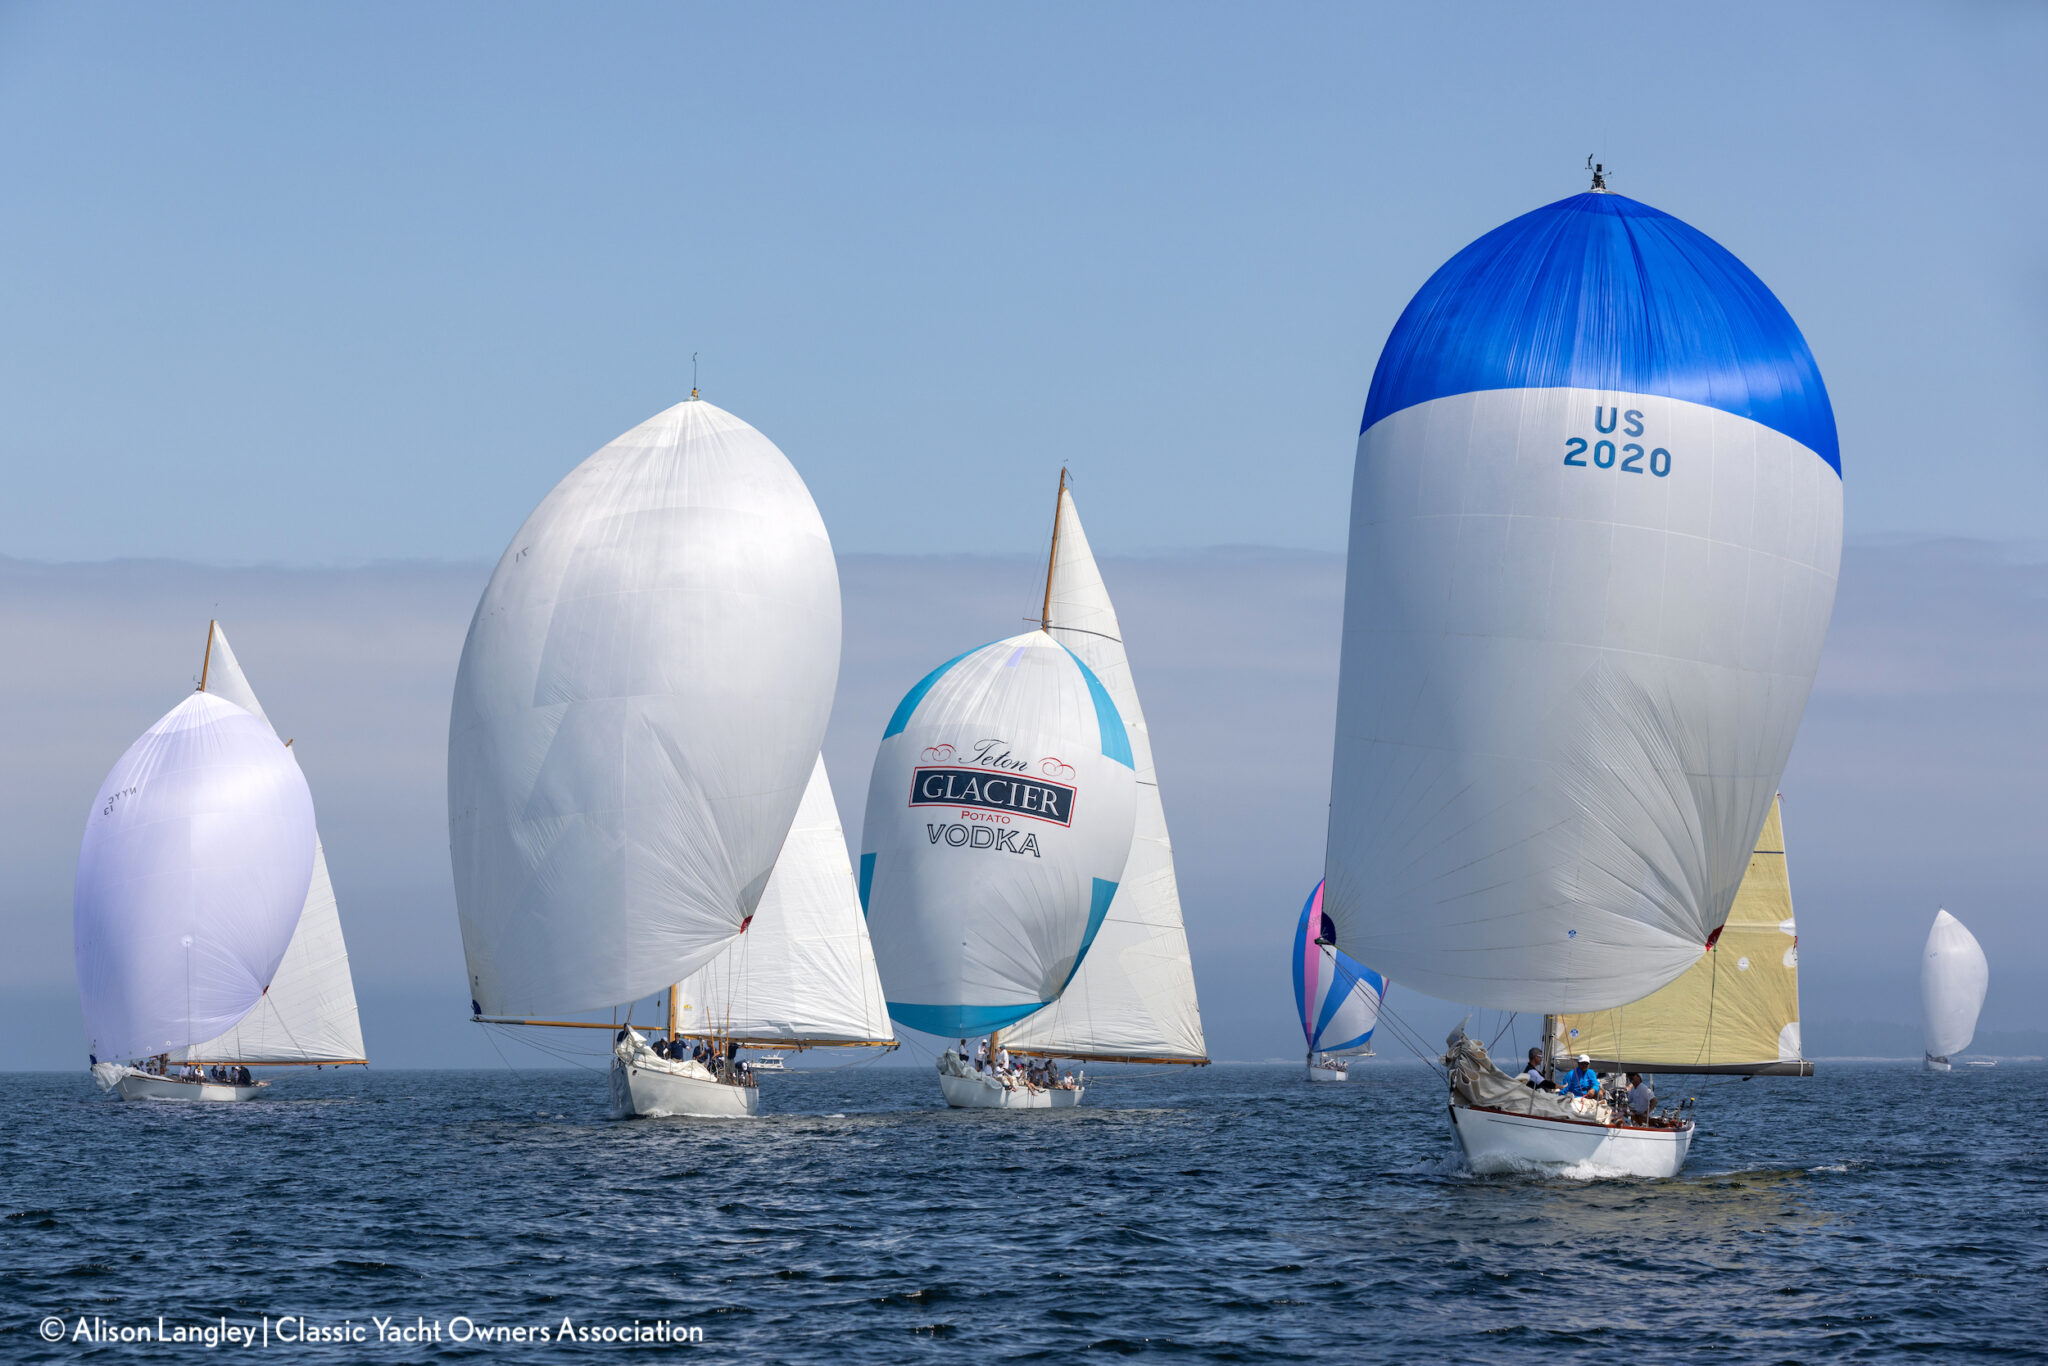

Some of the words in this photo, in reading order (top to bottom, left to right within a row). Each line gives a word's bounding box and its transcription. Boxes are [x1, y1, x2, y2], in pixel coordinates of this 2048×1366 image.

[1594, 405, 1645, 438] US
[1563, 437, 1672, 478] 2020
[958, 738, 1028, 772] Teton
[922, 774, 1060, 817] GLACIER
[961, 810, 1011, 825] POTATO
[926, 823, 1041, 858] VODKA
